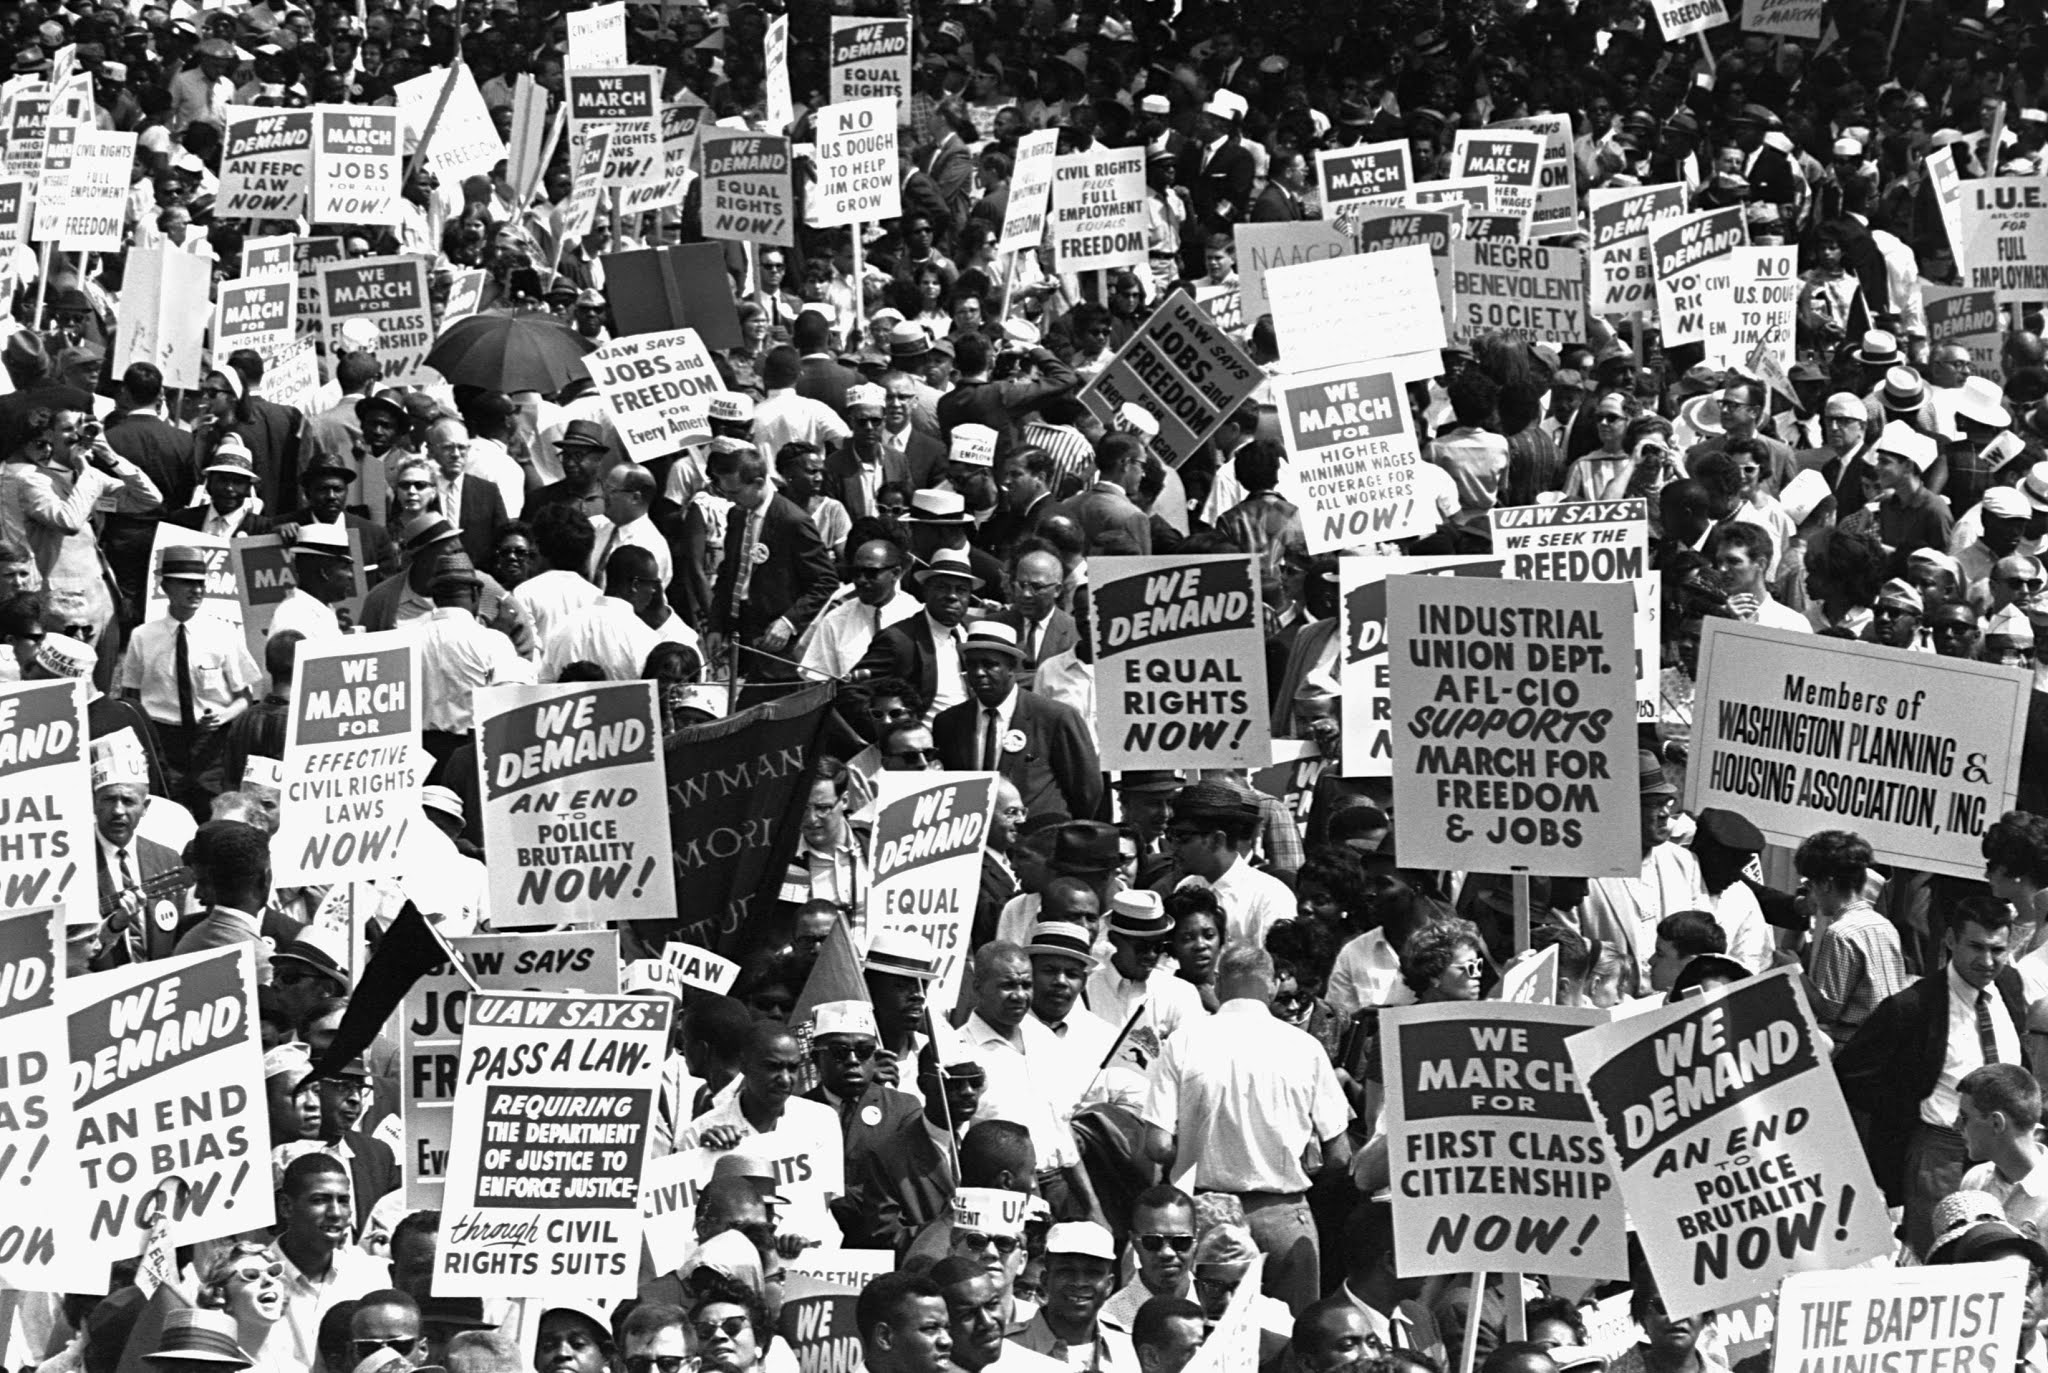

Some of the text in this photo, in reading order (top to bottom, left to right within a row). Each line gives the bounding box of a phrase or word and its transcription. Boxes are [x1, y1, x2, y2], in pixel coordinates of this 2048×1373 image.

[1662, 0, 1723, 28] FREEDOM
[844, 69, 900, 81] EQUAL
[843, 85, 903, 97] RIGHTS
[840, 111, 873, 130] NO
[76, 145, 131, 158] CIVIL RIGHTS
[847, 133, 893, 156] DOUGH
[261, 162, 303, 176] FEPC
[328, 162, 389, 179] JOBS
[830, 159, 885, 177] TO HELP
[1057, 160, 1141, 181] CIVIL RIGHTS
[70, 186, 125, 199] EMPLOYMENT
[244, 178, 288, 191] LAW
[717, 179, 780, 199] EQUAL
[824, 175, 892, 196] JIM CROW
[1082, 179, 1114, 189] PLUS
[228, 193, 297, 210] NOW!
[328, 197, 390, 214] NOW!
[716, 196, 782, 215] RIGHTS
[837, 195, 881, 212] GROW
[1059, 200, 1142, 222] EMPLOYMENT
[1976, 186, 2048, 210] I.U.E.
[65, 216, 119, 236] FREEDOM
[716, 214, 785, 236] NOW!
[1077, 218, 1126, 232] EQUALS
[1061, 232, 1143, 258] FREEDOM
[1252, 244, 1342, 271] NAACP
[1475, 243, 1549, 270] NEGRO
[1997, 236, 2027, 261] FULL
[1454, 271, 1582, 300] BENEVOLENT
[1469, 303, 1578, 331] SOCIETY
[596, 336, 686, 360] UAW SAYS
[1174, 305, 1250, 380] UAW SAYS
[603, 354, 704, 386] JOBS and
[1150, 322, 1234, 409] JOBS and
[611, 374, 719, 414] FREEDOM
[1124, 341, 1215, 435] FREEDOM
[1324, 381, 1359, 403] WE
[659, 405, 690, 418] FOR
[1300, 397, 1392, 433] MARCH
[627, 426, 667, 445] Every
[1321, 441, 1390, 464] HIGHER
[1300, 452, 1416, 484] MINIMUM WAGES
[1309, 469, 1415, 498] COVERAGE FOR
[1317, 484, 1413, 511] ALL WORKERS
[1324, 499, 1414, 541] NOW!
[1500, 501, 1644, 528] UAW SAYS:
[1507, 528, 1628, 549] WE SEEK THE
[1144, 568, 1201, 605] WE
[1108, 591, 1248, 647] DEMAND
[1419, 604, 1603, 640] INDUSTRIAL
[47, 646, 76, 667] FULL
[342, 658, 377, 682] WE
[1409, 639, 1612, 674] UNION DEPT.
[1125, 658, 1242, 683] EQUAL
[305, 682, 405, 721] MARCH
[1124, 690, 1248, 715] RIGHTS
[1434, 674, 1579, 708] AFL-CIO
[1784, 674, 1926, 721] Members of
[338, 719, 379, 737] FOR
[536, 696, 596, 739] WE
[1407, 705, 1613, 744] SUPPORTS
[1123, 718, 1252, 752] NOW!
[1718, 700, 1992, 785] WASHINGTON PLANNING &
[305, 746, 408, 774] EFFECTIVE
[496, 718, 645, 787] DEMAND
[1415, 745, 1611, 780] MARCH FOR
[289, 770, 414, 801] CIVIL RIGHTS
[1437, 779, 1600, 813] FREEDOM
[1710, 750, 1796, 804] HOUSING
[1797, 766, 1940, 835] ASSOCIATION,
[325, 801, 383, 823] LAWS
[510, 788, 638, 814] AN END
[913, 787, 956, 828] WE
[558, 812, 587, 820] TO
[300, 819, 408, 870] NOW!
[538, 820, 617, 843] POLICE
[879, 813, 982, 874] DEMAND
[1446, 814, 1583, 848] & JOBS
[517, 842, 634, 866] BRUTALITY
[517, 856, 656, 905] NOW!
[886, 888, 959, 915] EQUAL
[515, 948, 595, 975] SAYS
[669, 950, 725, 983] UAW
[110, 976, 180, 1037] WE
[476, 1000, 664, 1029] UAW SAYS:
[71, 996, 241, 1101] DEMAND
[1470, 1027, 1528, 1052] WE
[1655, 1008, 1725, 1077] WE
[466, 1042, 549, 1085] PASS
[551, 1038, 575, 1072] A
[1418, 1057, 1584, 1094] MARCH
[1623, 1020, 1799, 1149] DEMAND
[77, 1084, 247, 1149] AN END
[491, 1094, 633, 1120] REQUIRING
[1472, 1095, 1536, 1111] FOR
[487, 1121, 640, 1145] THE DEPARTMENT
[1653, 1107, 1809, 1178] AN END
[80, 1125, 249, 1188] TO BIAS
[484, 1149, 628, 1172] OF JUSTICE TO
[1407, 1130, 1605, 1164] FIRST CLASS
[1714, 1156, 1752, 1170] TO
[479, 1176, 561, 1198] ENFORCE
[1401, 1166, 1611, 1200] CITIZENSHIP
[1695, 1154, 1796, 1205] POLICE
[90, 1160, 250, 1241] NOW!
[1677, 1173, 1823, 1239] BRUTALITY
[451, 1212, 618, 1250] through CIVIL
[1427, 1213, 1600, 1256] NOW!
[1694, 1184, 1855, 1285] NOW!
[444, 1252, 626, 1275] RIGHTS SUITS
[797, 1300, 834, 1342] WE
[1801, 1300, 1852, 1350] THE
[1863, 1291, 2005, 1346] BAPTIST
